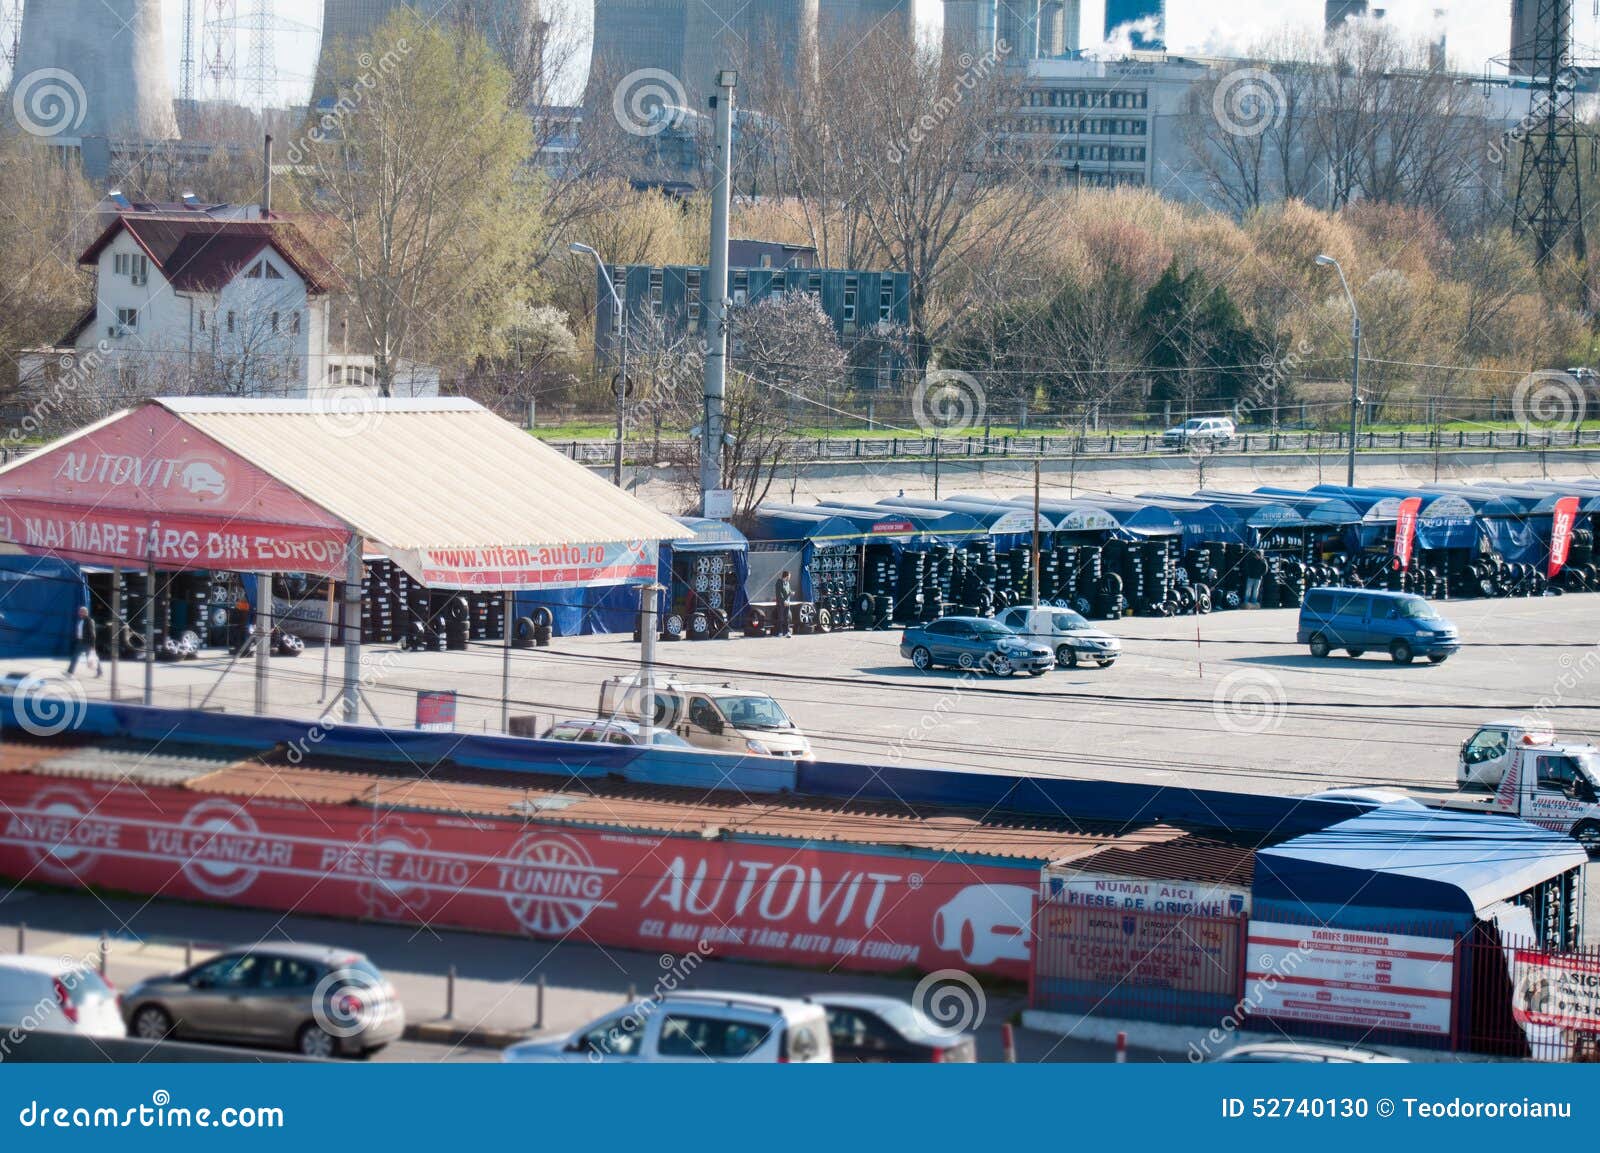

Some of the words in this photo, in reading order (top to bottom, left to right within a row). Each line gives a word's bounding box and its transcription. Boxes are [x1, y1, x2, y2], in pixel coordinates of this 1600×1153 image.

[54, 452, 184, 488] AUTOVIT
[25, 518, 65, 548] MAI
[71, 520, 129, 554] MARE
[136, 521, 199, 557] TÂRG
[207, 532, 249, 559] DIN
[254, 536, 348, 564] EUROP
[428, 544, 605, 567] www.vitan-auto.ro
[5, 816, 122, 848] ANVELOPE
[146, 828, 294, 865] VULCANIZARI
[320, 848, 395, 877] PIESE
[399, 855, 469, 884] AUTO
[496, 867, 603, 899] TUNING
[640, 856, 902, 929] AUTOVIT
[1095, 881, 1149, 895] NUMAI
[1160, 886, 1193, 899] AICI
[1070, 891, 1114, 907] PIESE
[1124, 897, 1144, 909] DE
[1154, 900, 1221, 917] ORIGINE
[640, 919, 664, 937] CEL
[668, 923, 698, 941] MAI
[750, 927, 788, 948] TÂRG
[791, 935, 832, 953] AUTO
[833, 938, 858, 955] DIN
[861, 942, 921, 962] EUROPA
[1312, 930, 1341, 941] TARIFE
[1343, 933, 1389, 946] DUMINICA
[1558, 972, 1600, 988] ASIG
